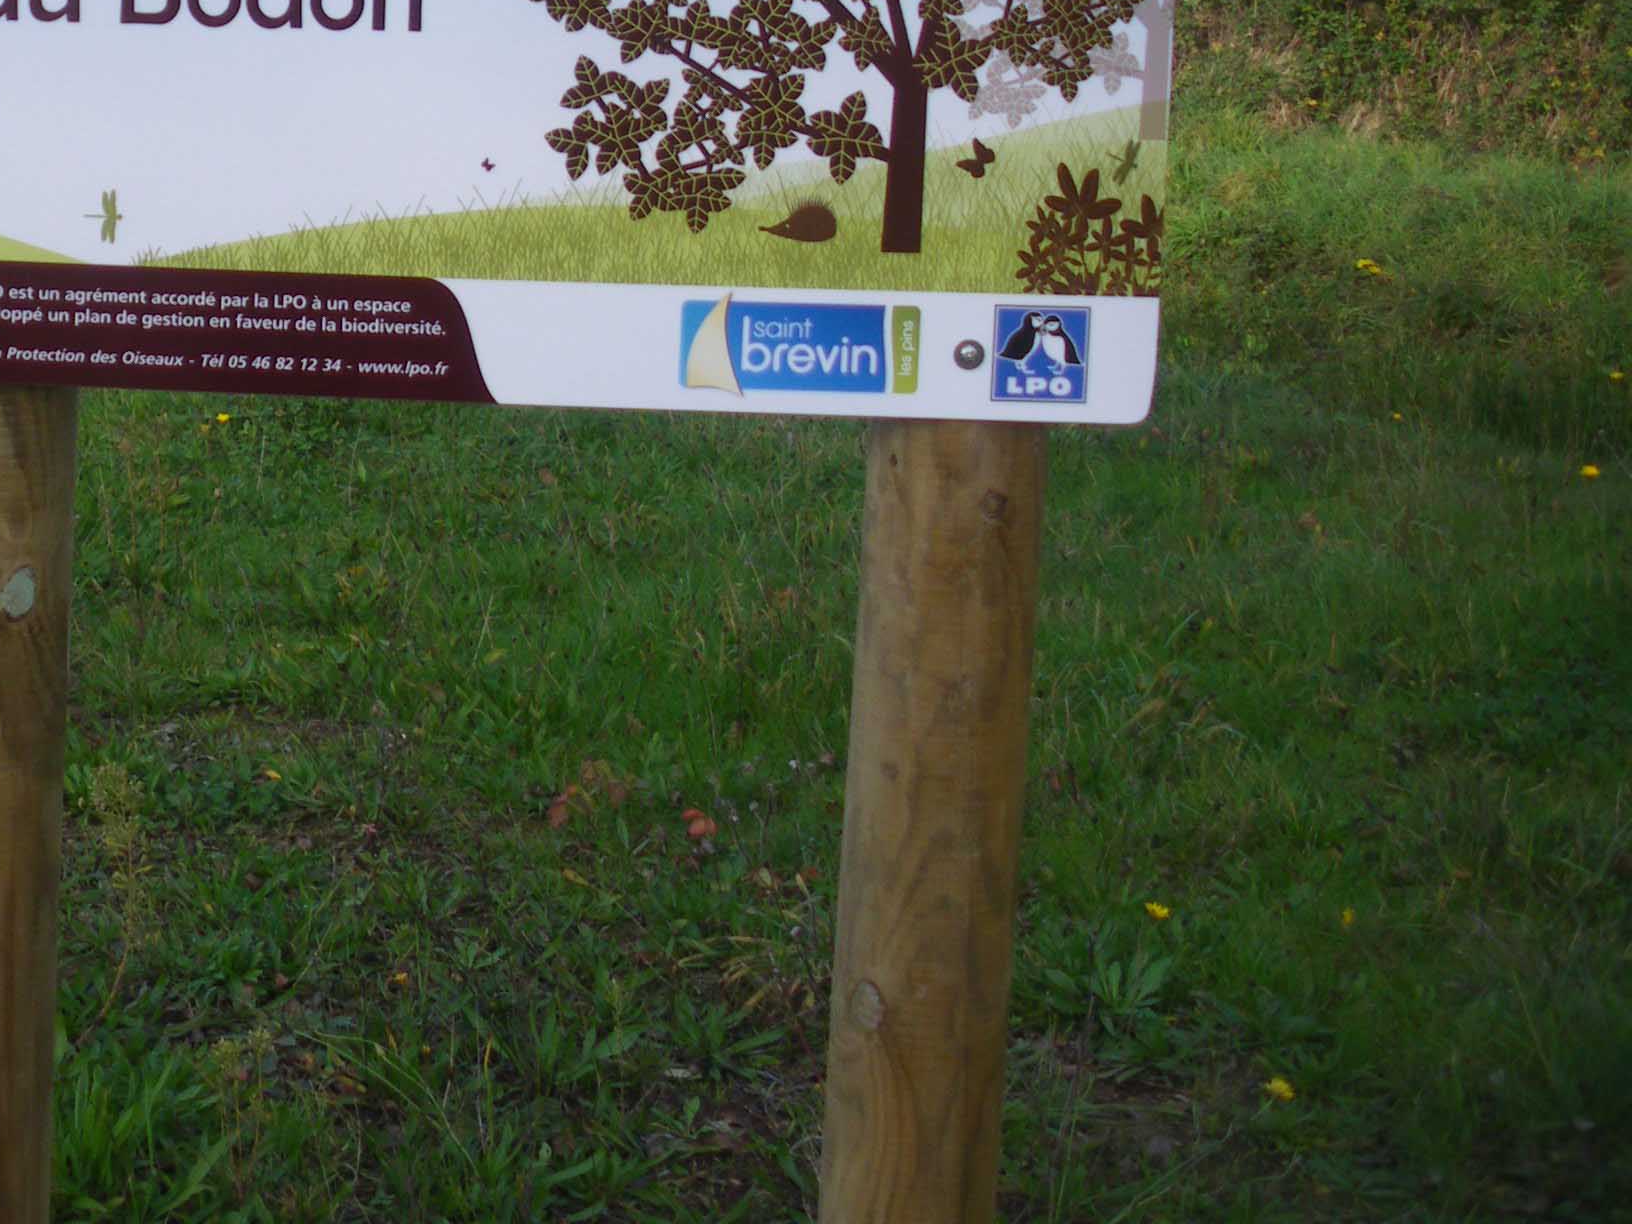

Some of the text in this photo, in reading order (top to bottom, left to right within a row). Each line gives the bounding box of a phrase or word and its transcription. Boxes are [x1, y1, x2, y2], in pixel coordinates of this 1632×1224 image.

[8, 287, 35, 300] est
[39, 288, 60, 301] un
[64, 288, 147, 306] agrément
[151, 290, 216, 307] accordé
[220, 294, 248, 310] par
[254, 292, 268, 308] la
[273, 294, 307, 310] LPO
[311, 295, 321, 310] à
[327, 299, 349, 312] un
[353, 300, 411, 314] espace
[48, 310, 69, 323] un
[74, 308, 111, 327] plan
[116, 309, 138, 325] de
[142, 311, 205, 329] gestion
[209, 316, 231, 329] en
[235, 313, 291, 331] faveur
[295, 316, 317, 332] de
[321, 317, 336, 332] la
[341, 317, 447, 336] biodiversité.
[752, 317, 814, 338] saint
[902, 319, 916, 352] pins
[741, 315, 879, 375] brevin
[6, 346, 85, 363] Protection
[90, 349, 117, 364] des
[122, 350, 184, 367] Oiseaux
[228, 354, 247, 369] 05
[251, 355, 271, 370] 46
[275, 356, 295, 371] 82
[299, 357, 318, 372] 12
[321, 358, 342, 373] 34
[357, 360, 449, 378] www.lpo.fr
[1006, 376, 1072, 397] LPO
